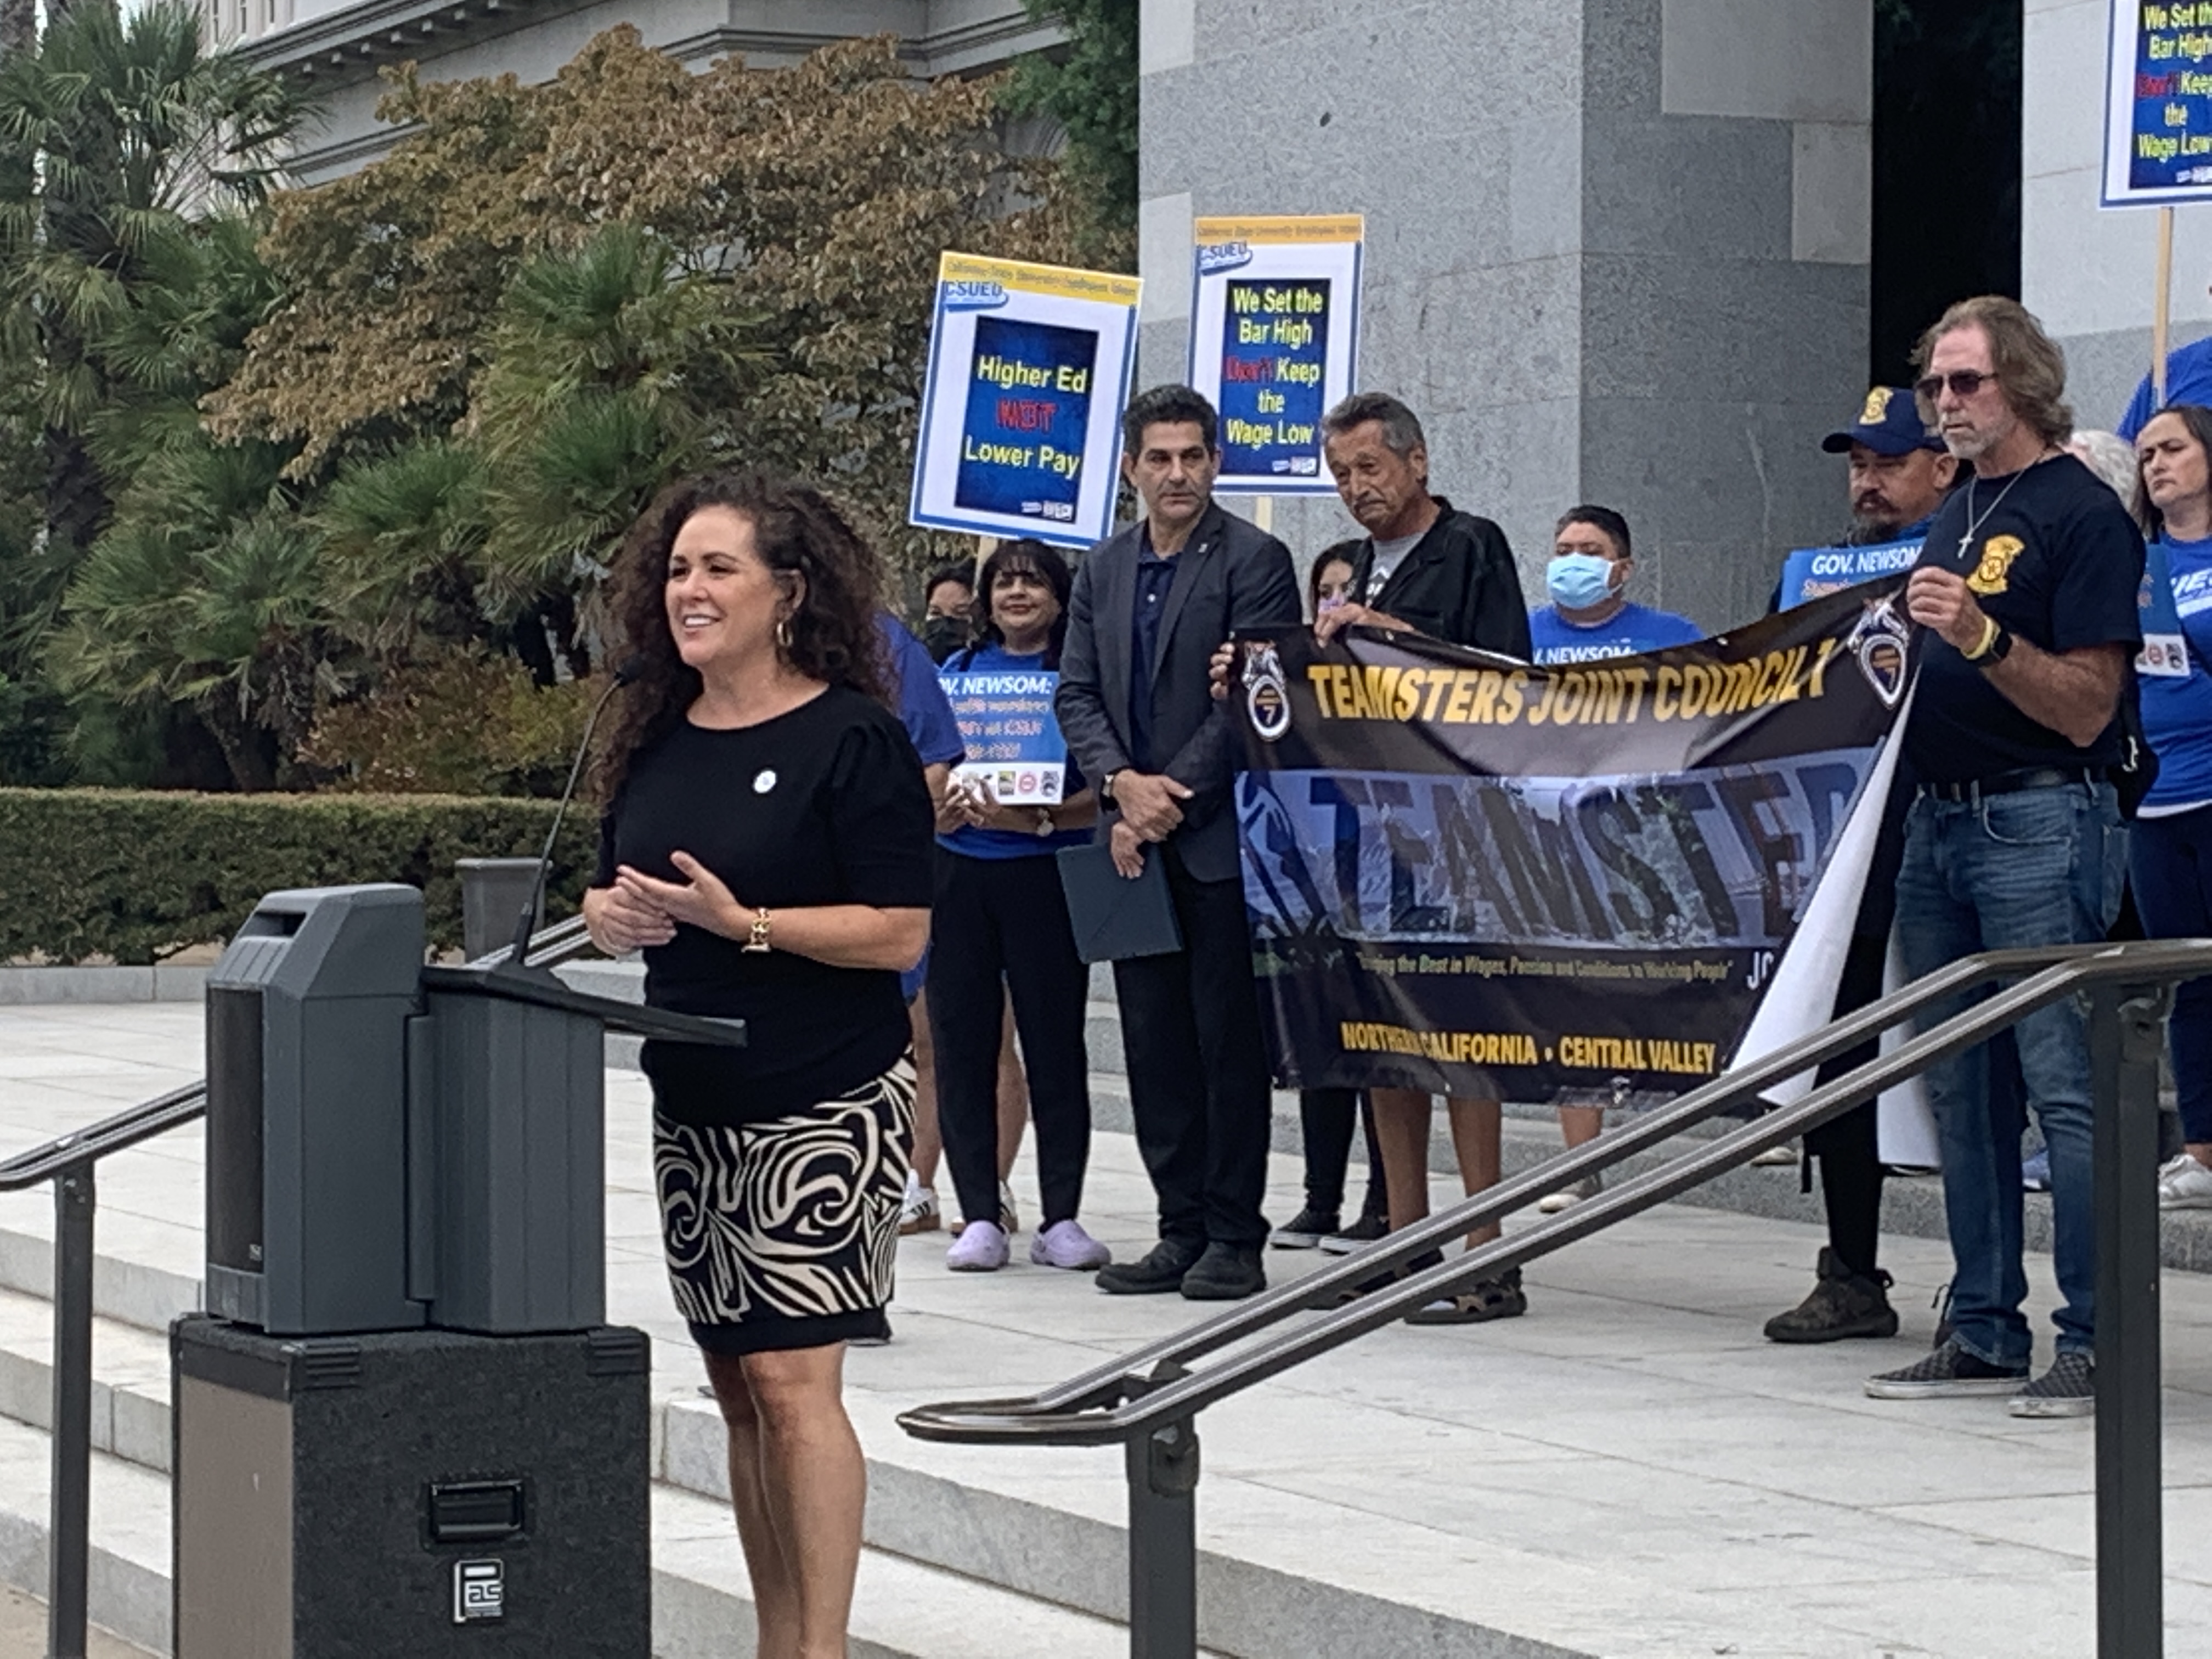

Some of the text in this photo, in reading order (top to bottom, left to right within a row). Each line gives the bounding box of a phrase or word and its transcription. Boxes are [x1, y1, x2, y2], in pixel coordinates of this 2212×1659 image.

[1233, 287, 1323, 313] We Set the
[1239, 318, 1313, 350] Bar High
[977, 355, 1087, 393] Higher Ed
[1276, 363, 1321, 388] Keep
[1258, 389, 1285, 414] the
[1227, 419, 1314, 450] Wage Low
[964, 434, 1080, 480] Lower Pay
[1812, 554, 1854, 575] GOV.
[962, 675, 1053, 695] NEWSOM:
[1307, 664, 1531, 725] TEAMSTERS
[1528, 666, 1649, 726] JOINT
[1653, 644, 1809, 722] COUNCIL
[1560, 1036, 1646, 1071] CENTRAL
[1647, 1039, 1717, 1074] VALLEY
